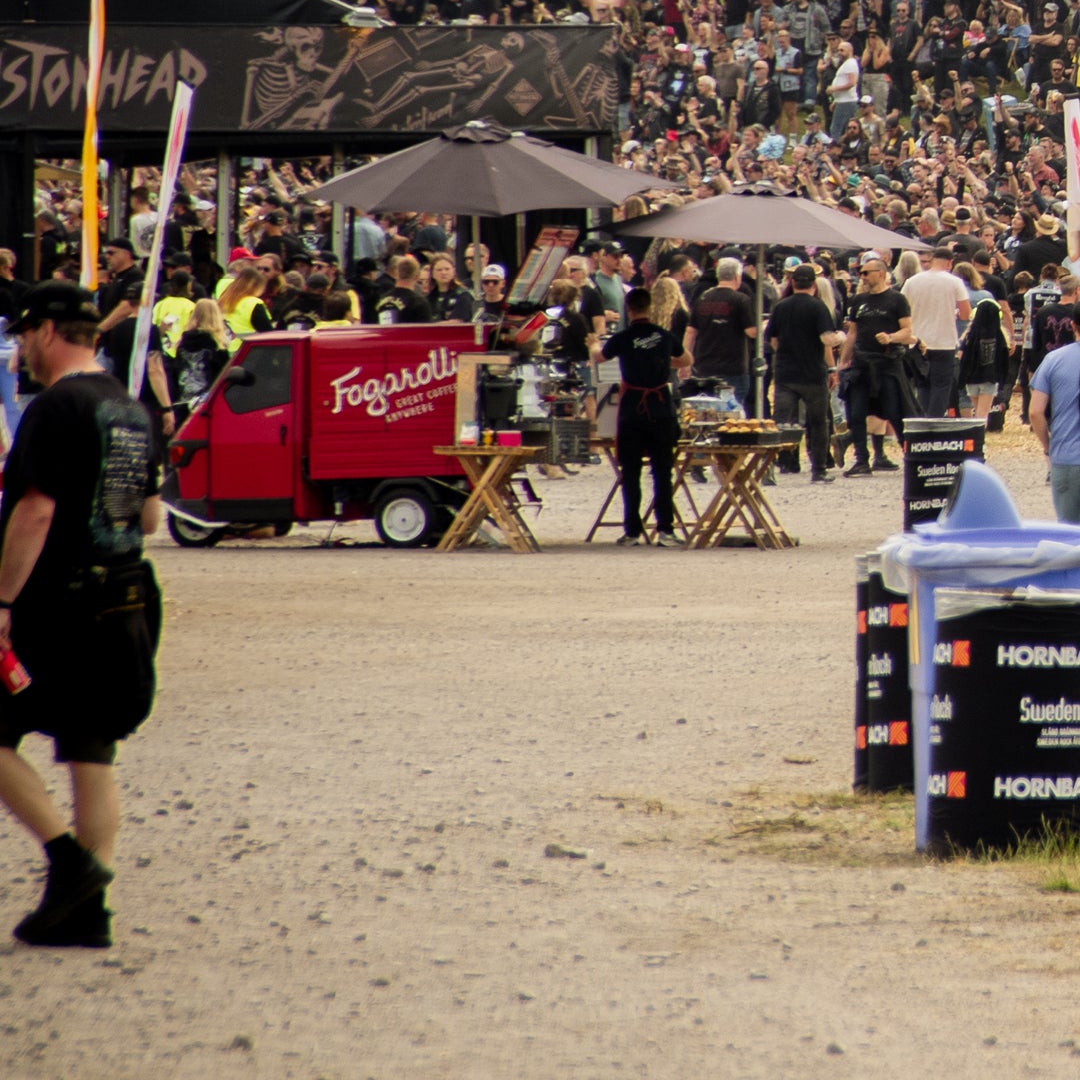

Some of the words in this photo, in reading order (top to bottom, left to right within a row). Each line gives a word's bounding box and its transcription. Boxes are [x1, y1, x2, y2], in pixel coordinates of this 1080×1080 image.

[330, 347, 458, 416] Fogarolli
[395, 392, 425, 409] GREAT
[911, 440, 963, 452] HORNBACH
[917, 464, 945, 477] Sweden
